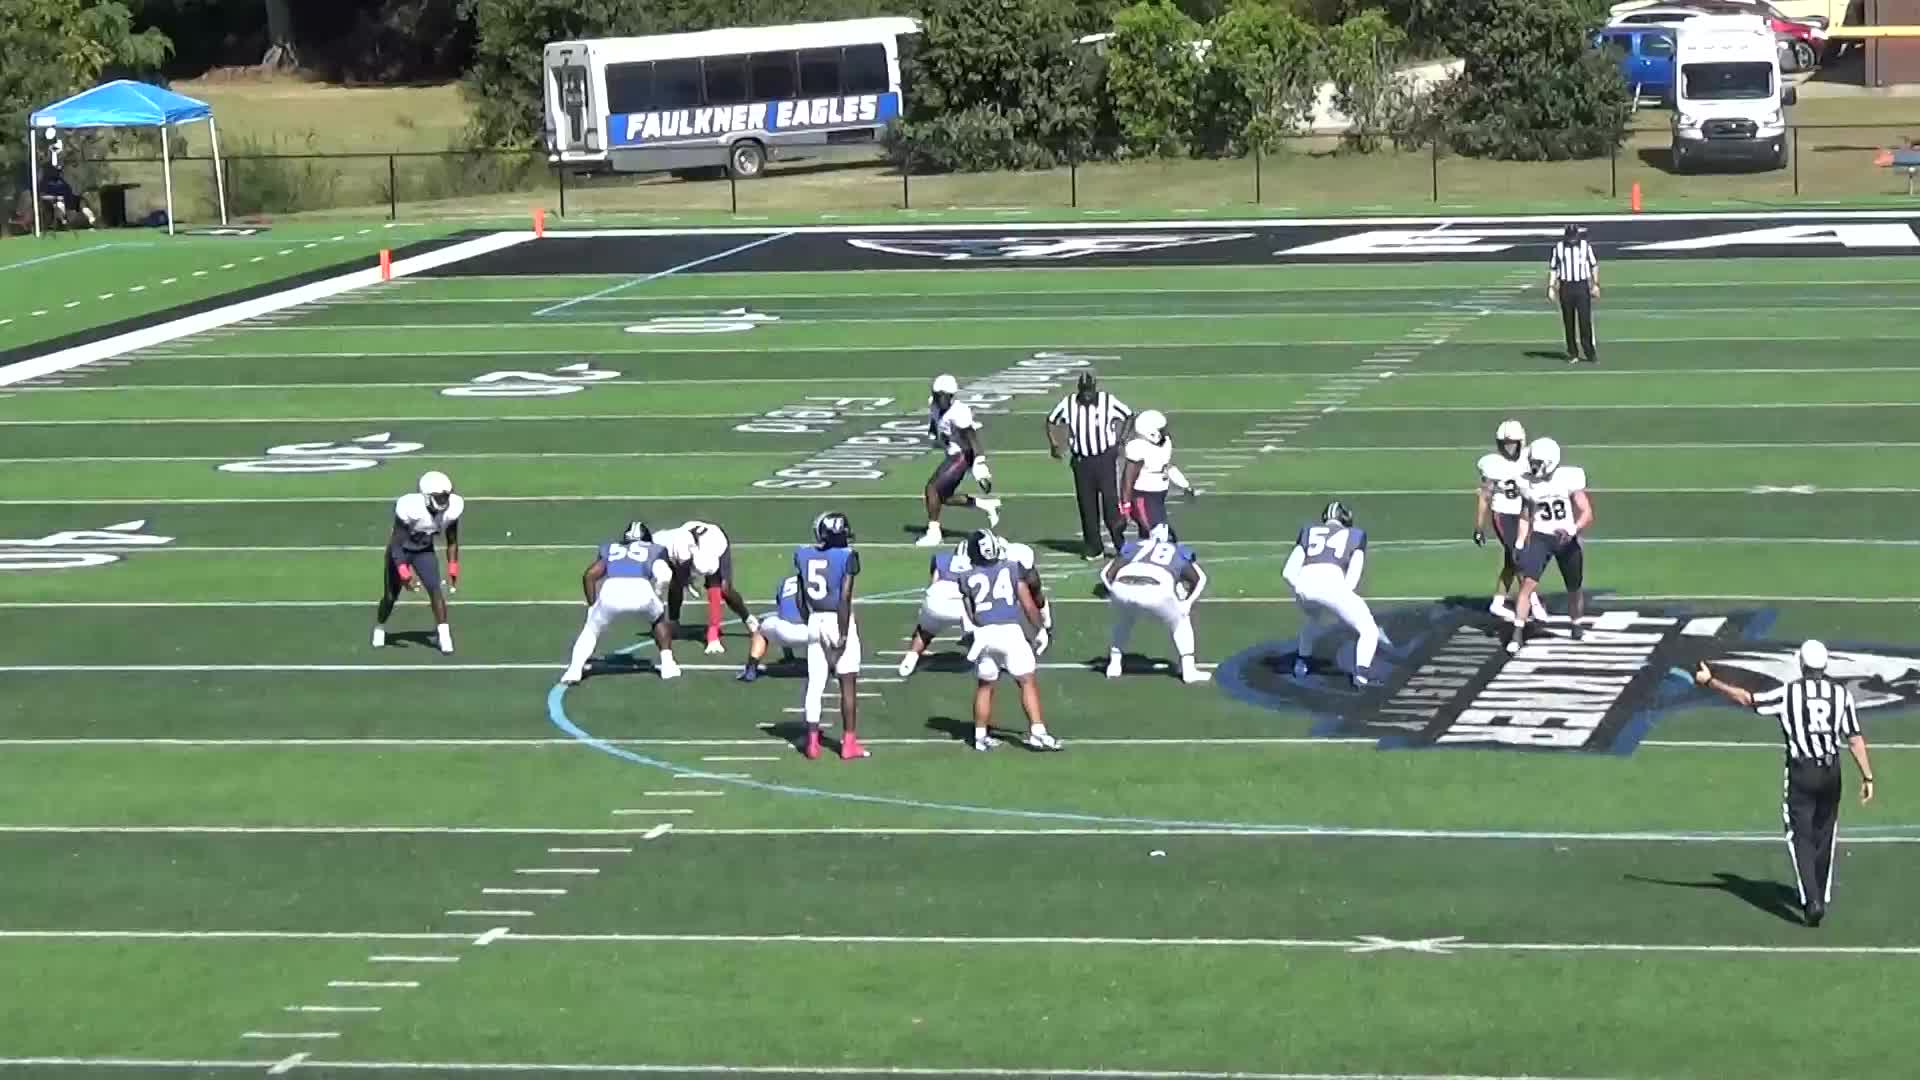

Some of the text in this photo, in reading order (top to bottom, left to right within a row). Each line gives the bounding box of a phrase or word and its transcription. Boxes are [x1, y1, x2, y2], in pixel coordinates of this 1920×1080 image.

[626, 95, 878, 141] FAULKNER EAGLES
[1306, 527, 1350, 559] 54
[807, 559, 828, 600] 5
[967, 567, 1015, 612] 24
[1806, 699, 1832, 732] R
